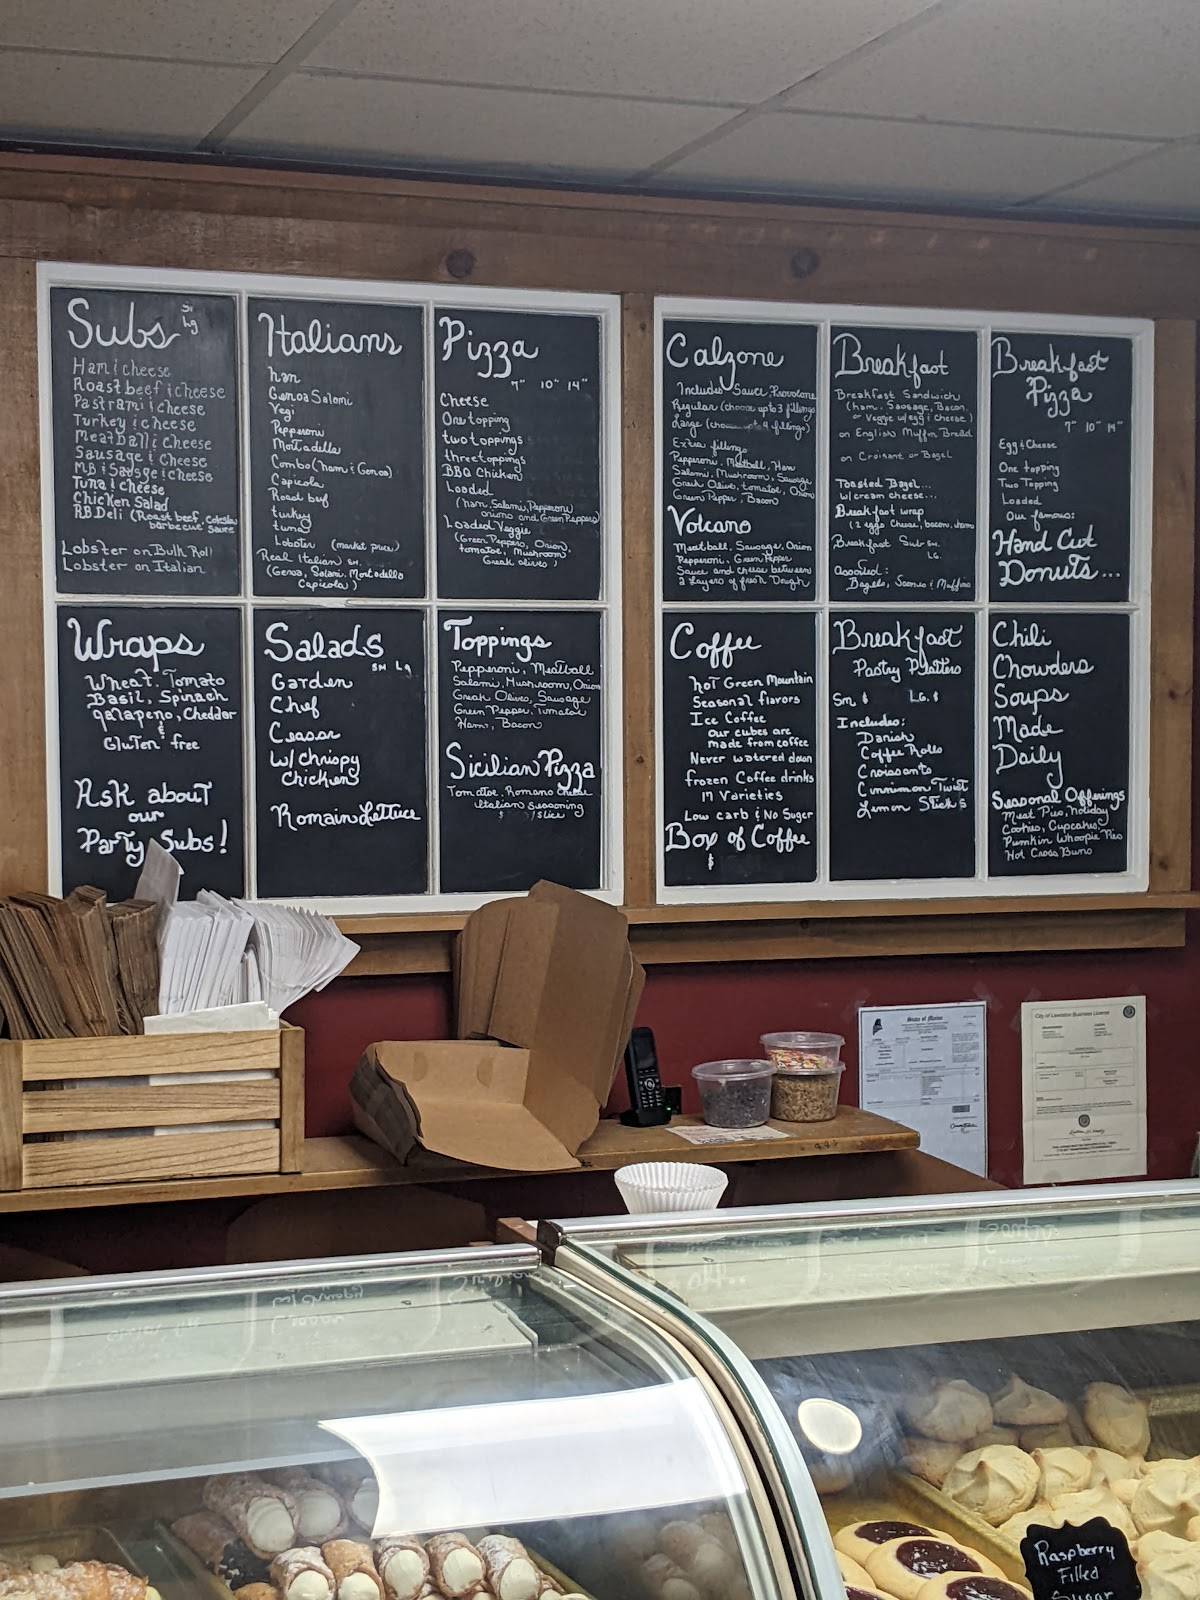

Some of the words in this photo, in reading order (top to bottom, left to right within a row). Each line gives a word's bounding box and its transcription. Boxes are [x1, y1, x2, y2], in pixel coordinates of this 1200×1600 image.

[68, 298, 181, 349] Subs
[258, 312, 403, 357] Italians
[439, 317, 539, 378] Pizza
[73, 357, 108, 376] Ham
[666, 333, 784, 390] Calzone
[832, 333, 949, 389] Breakfast
[991, 337, 1109, 382] Breakfast
[74, 377, 121, 394] Roast
[125, 380, 162, 396] beef
[835, 389, 896, 400] Breakfast
[902, 389, 961, 401] Sandwich
[74, 394, 144, 411] Pastrami
[1026, 376, 1092, 418] Pizza
[672, 399, 718, 417] Regular
[73, 413, 126, 433] Turkey
[442, 464, 472, 477] BBQ
[476, 467, 524, 481] Chicken
[1024, 460, 1060, 476] topping
[72, 475, 106, 490] Tuna
[446, 481, 494, 496] Loaded
[835, 478, 883, 488] Toasted
[999, 478, 1019, 489] Two
[73, 492, 130, 507] Chicken
[135, 497, 169, 512] Salad
[1002, 493, 1042, 505] Loaded
[668, 505, 751, 536] Volcano
[835, 504, 895, 521] Breakfast
[901, 508, 924, 520] wrap
[443, 514, 495, 531] Loaded
[62, 540, 127, 555] Lobster
[133, 547, 150, 555] on
[992, 529, 1052, 556] Hand
[1057, 524, 1098, 550] Cut
[256, 548, 293, 562] Real
[63, 558, 127, 572] Lobster
[152, 560, 206, 574] Italian
[713, 565, 734, 574] and
[264, 622, 385, 663] Salads
[443, 616, 552, 662] Toppings
[992, 620, 1051, 648] Chili
[67, 618, 204, 672] Wraps
[670, 622, 762, 669] Coffee
[832, 619, 963, 668] Breakfast
[853, 658, 901, 683] Pastry
[993, 650, 1094, 679] Chowders
[163, 669, 225, 688] Tomato
[272, 672, 353, 690] Garden
[724, 677, 764, 688] Green
[159, 688, 228, 706] Spinach
[693, 694, 753, 709] Seasonal
[758, 691, 800, 706] flavors
[994, 683, 1069, 715] Soups
[271, 696, 320, 718] Chef
[690, 712, 718, 726] Ice
[725, 712, 766, 724] Coffee
[708, 729, 729, 737] our
[735, 727, 768, 737] cubes
[773, 728, 792, 736] are
[993, 715, 1063, 742] Made
[171, 733, 200, 750] free
[708, 738, 742, 748] made
[747, 737, 774, 747] from
[777, 738, 809, 747] coffee
[856, 732, 914, 746] Danish
[690, 752, 725, 764] Never
[733, 753, 784, 763] watered
[789, 753, 812, 763] down
[861, 746, 904, 763] Coffee
[905, 744, 942, 757] Rolls
[446, 742, 540, 779] Sicilian
[538, 748, 596, 790] Pizza
[992, 744, 1063, 789] Daily
[685, 770, 728, 787] frozen
[736, 771, 776, 783] Coffee
[781, 769, 814, 783] drinks
[719, 789, 783, 801] Varieties
[992, 790, 1061, 810] Seasonal
[1065, 787, 1125, 810] Offerings
[128, 810, 164, 822] our
[685, 809, 709, 821] Low
[717, 809, 748, 820] carb
[764, 809, 778, 820] No
[857, 801, 910, 819] Lemon
[1002, 810, 1035, 824] Meat
[160, 819, 228, 854] Subs!
[666, 822, 718, 851] Box
[728, 826, 746, 851] of
[752, 823, 810, 853] Coffee
[1057, 833, 1100, 844] Whoopie
[1005, 850, 1025, 861] Hot
[1031, 848, 1058, 857] Cross
[1034, 1540, 1115, 1566] Raspberry
[1057, 1565, 1099, 1584] Filled
